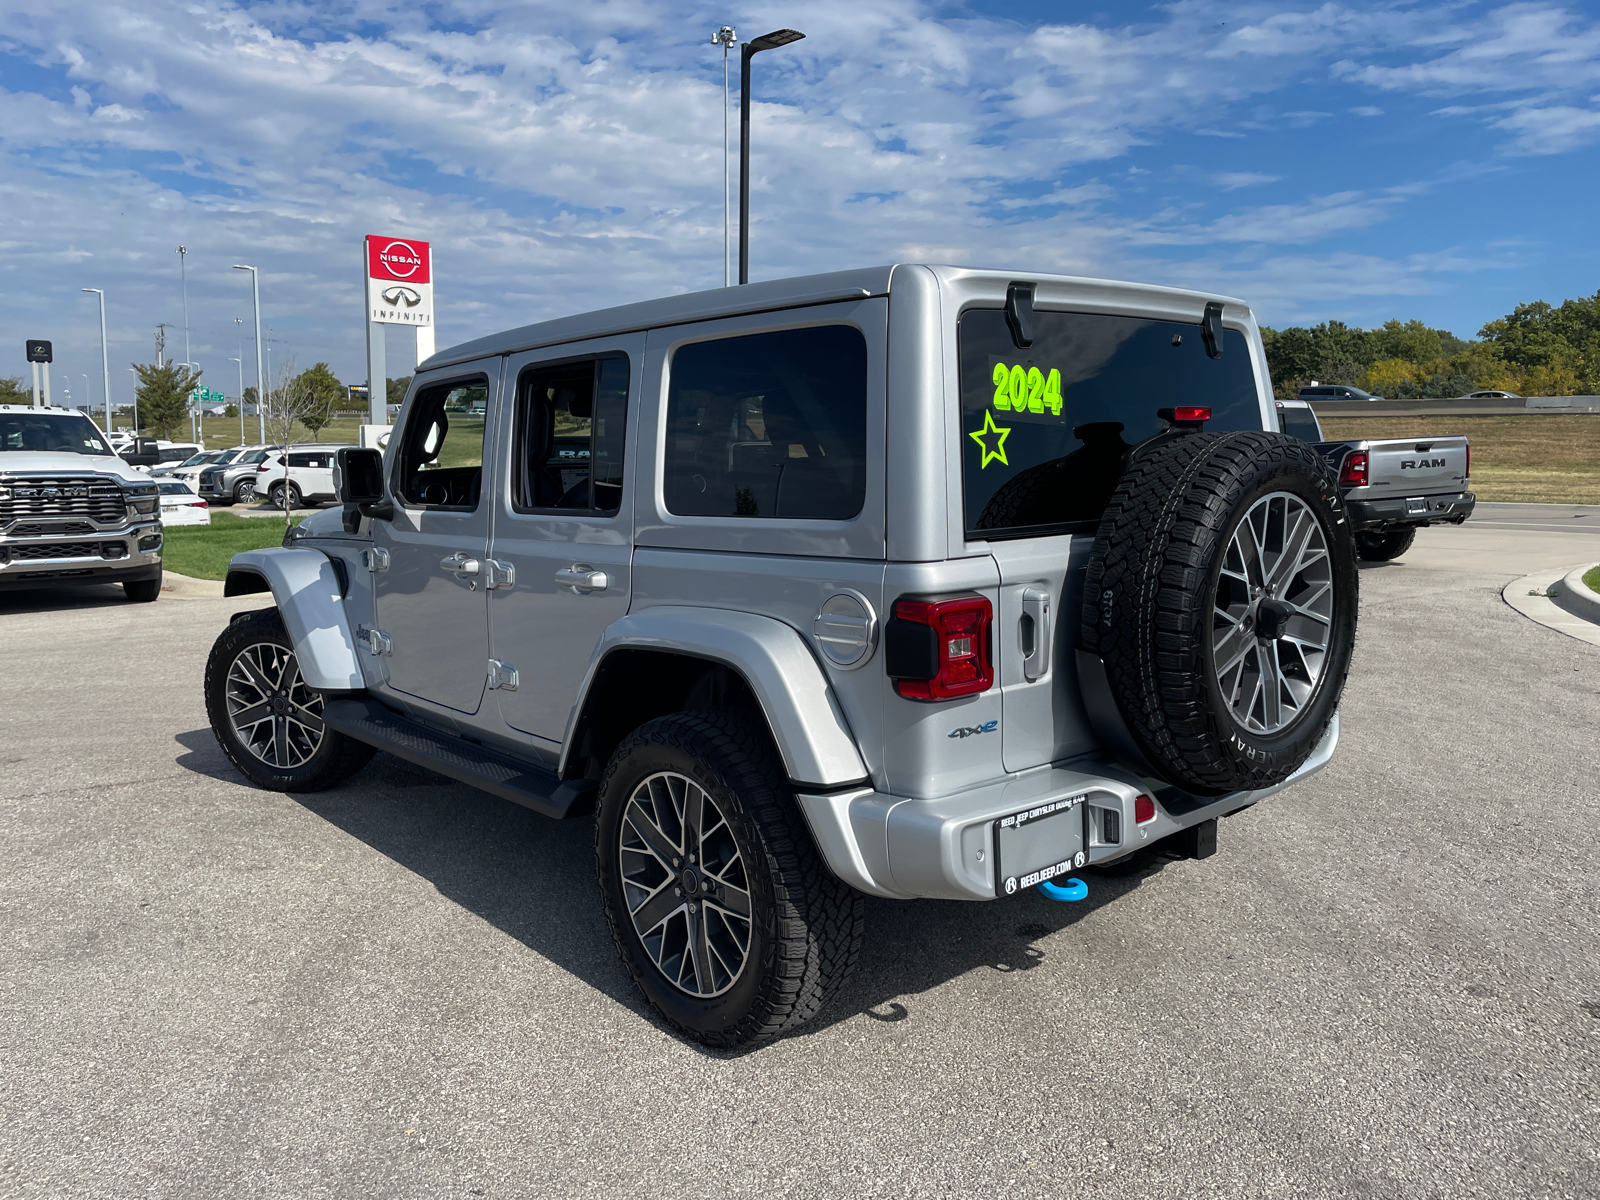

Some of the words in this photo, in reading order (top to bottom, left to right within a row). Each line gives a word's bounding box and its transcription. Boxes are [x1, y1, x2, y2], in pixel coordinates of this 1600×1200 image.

[380, 253, 421, 265] NISSAN
[373, 309, 430, 322] INFINITI
[992, 362, 1064, 416] 2024
[1401, 458, 1446, 470] RAM
[13, 487, 88, 498] RAM
[1001, 816, 1015, 828] REED
[1016, 811, 1029, 823] JEEP
[1029, 804, 1055, 818] CHRYSLER
[1020, 859, 1072, 889] REEDJEEP.COM
